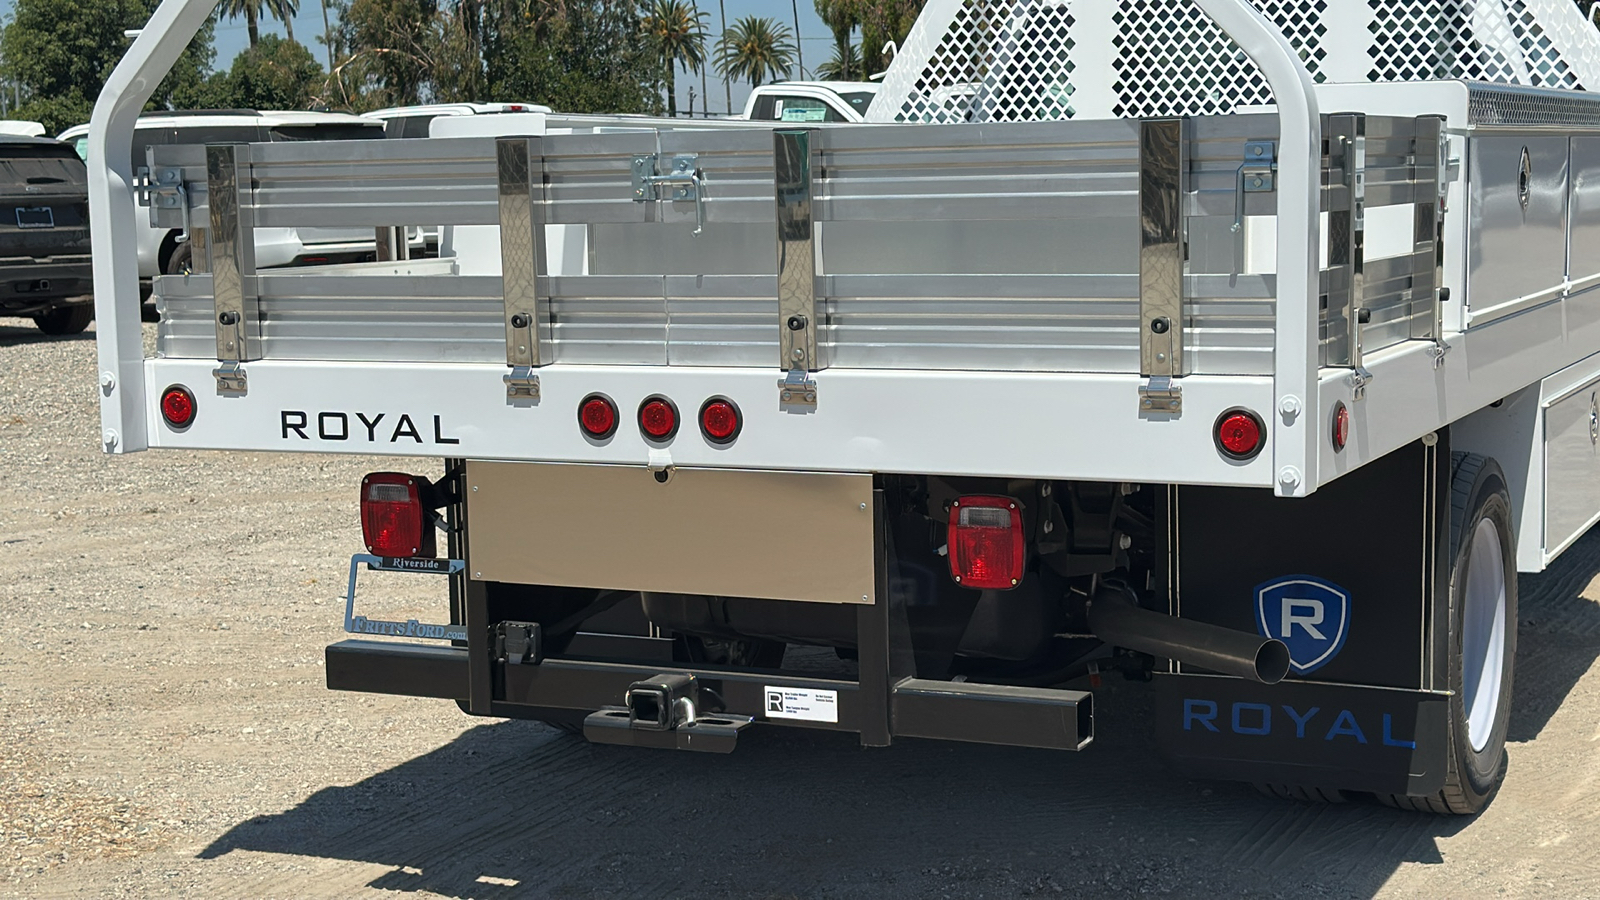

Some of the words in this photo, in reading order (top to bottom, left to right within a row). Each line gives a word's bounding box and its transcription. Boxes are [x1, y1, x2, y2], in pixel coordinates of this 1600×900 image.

[281, 410, 460, 444] ROYAL
[392, 557, 439, 569] Riverside
[1281, 598, 1327, 640] R
[768, 692, 783, 711] R
[1183, 698, 1416, 750] ROYAL
